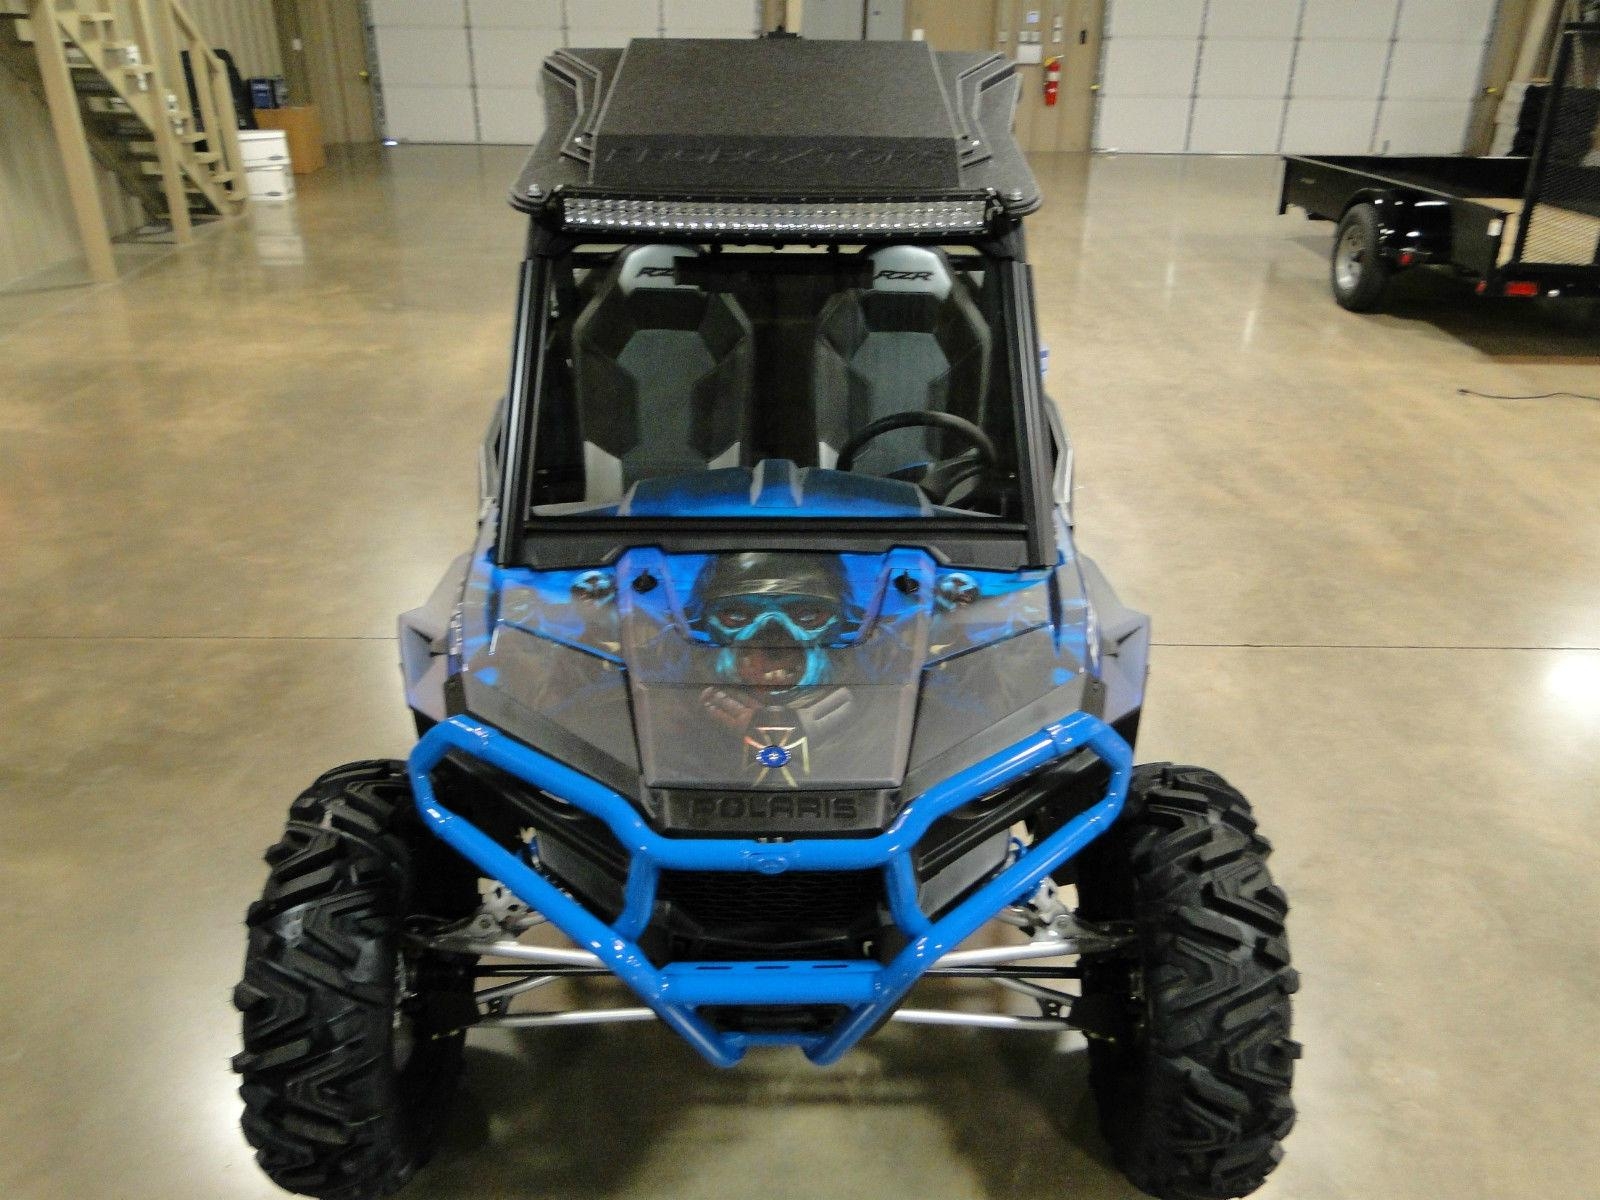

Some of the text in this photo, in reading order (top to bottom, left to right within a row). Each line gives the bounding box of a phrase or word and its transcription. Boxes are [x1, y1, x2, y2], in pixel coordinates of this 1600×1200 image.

[636, 267, 676, 278] RZ
[873, 270, 933, 281] RZR
[689, 796, 857, 818] POLARIS
